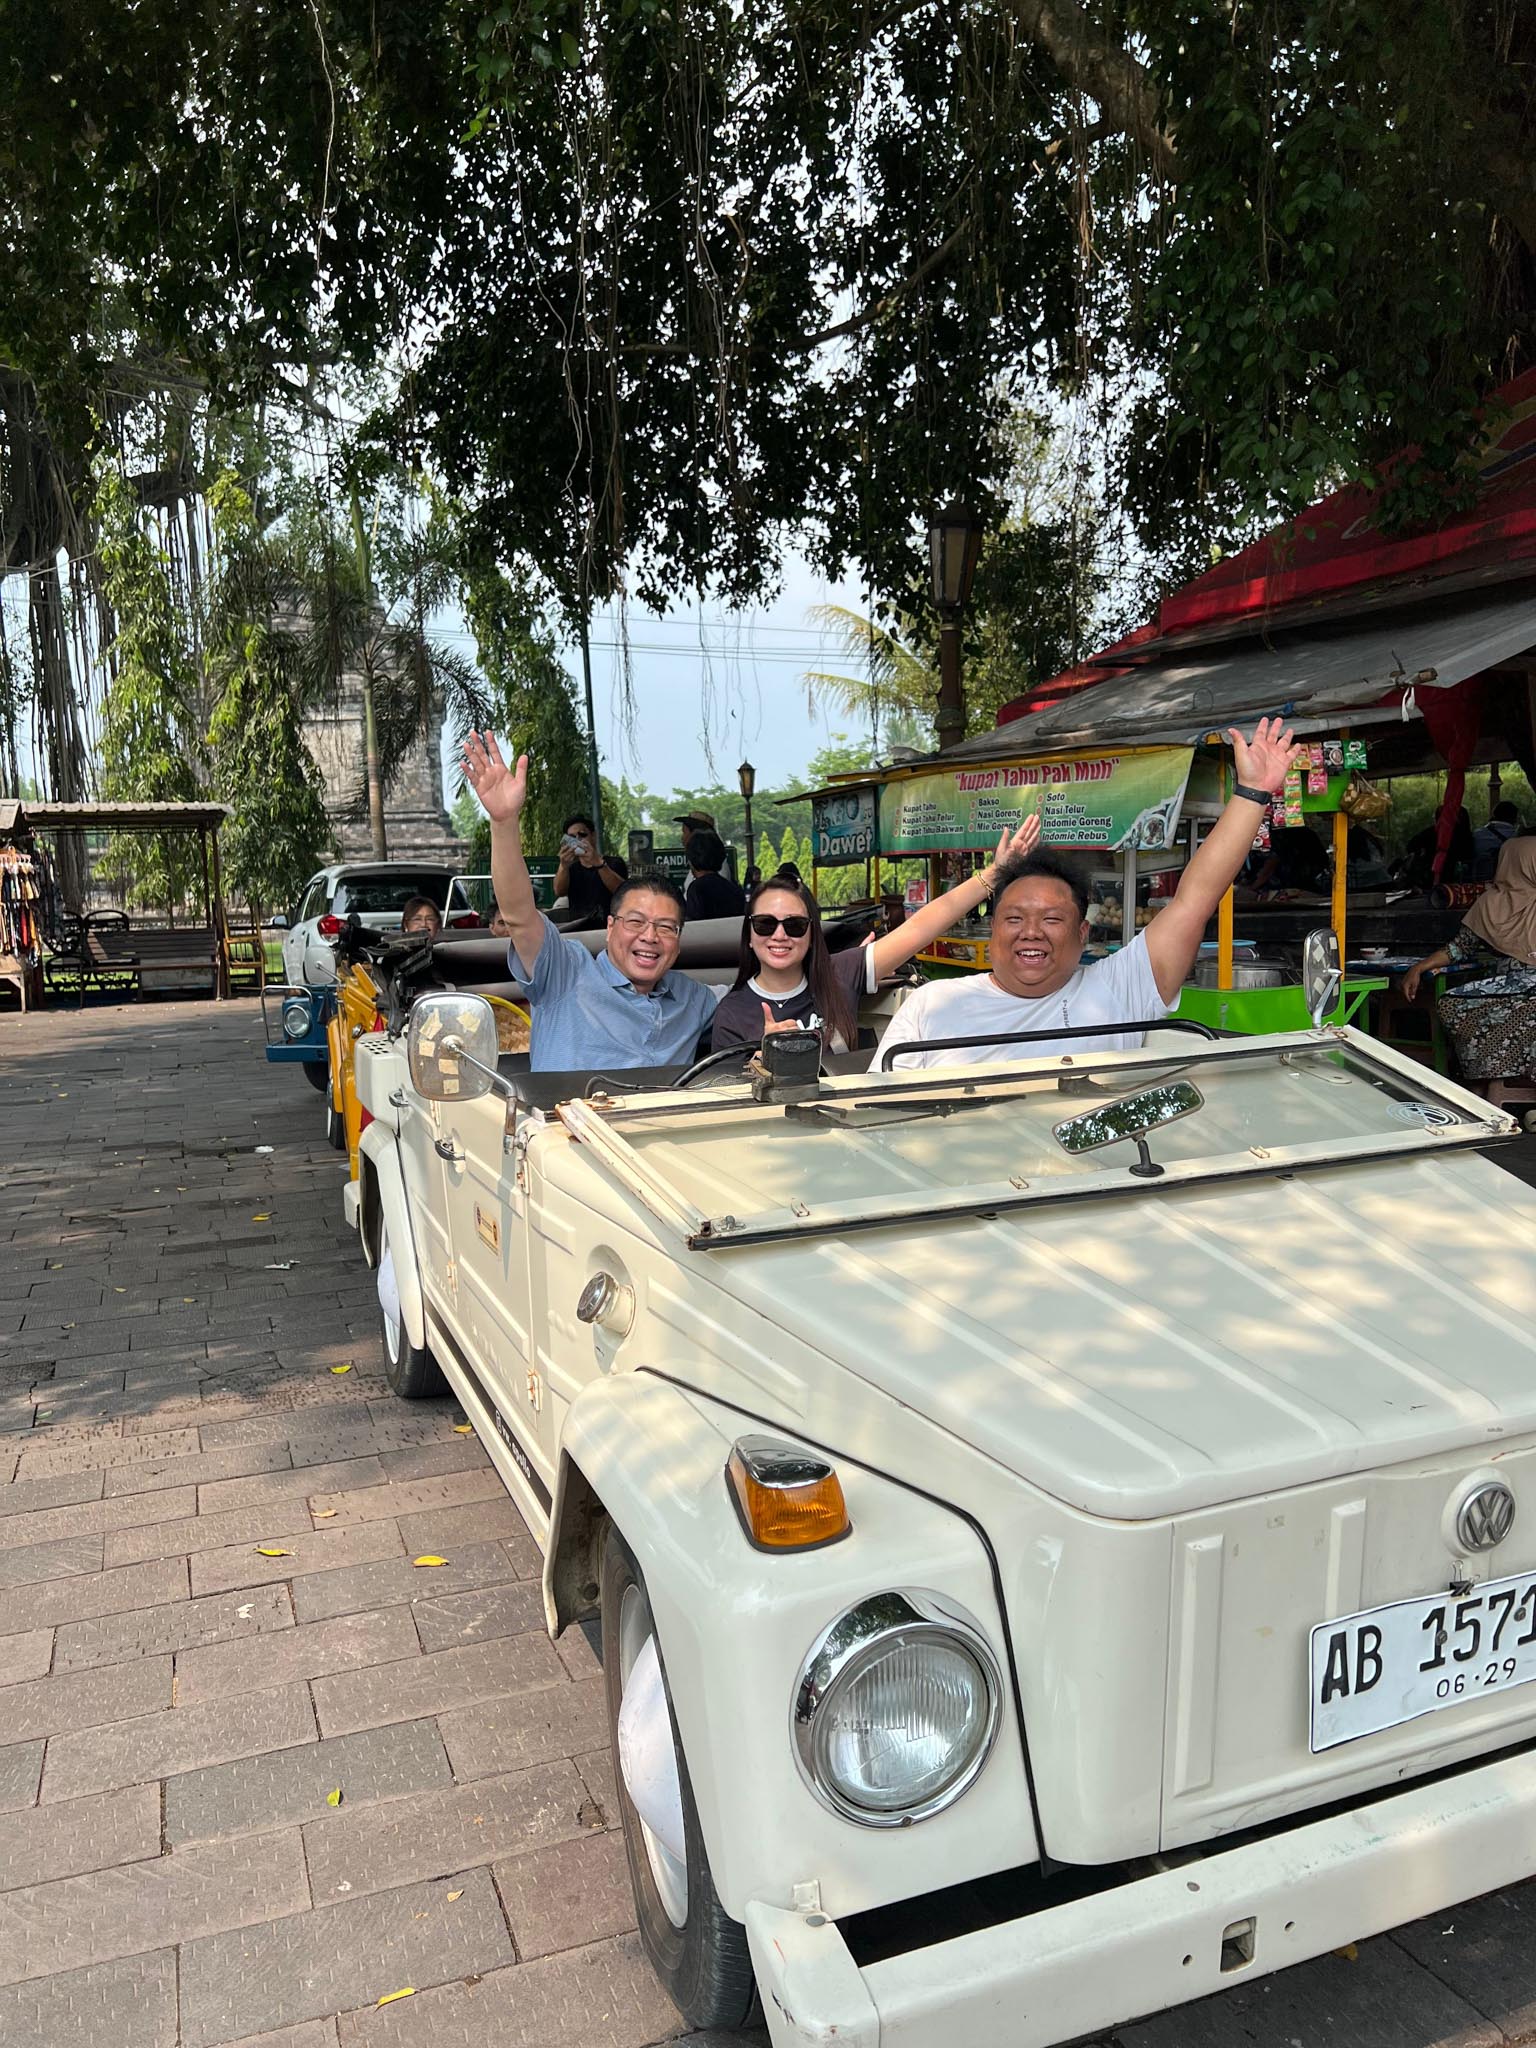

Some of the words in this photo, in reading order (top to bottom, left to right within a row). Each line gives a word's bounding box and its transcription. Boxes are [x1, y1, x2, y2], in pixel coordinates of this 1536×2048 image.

[1002, 767, 1038, 787] Tahu
[1041, 763, 1071, 784] Pak
[1046, 793, 1065, 801] Soto
[979, 798, 999, 807] Bakso
[903, 804, 922, 812] Kupat
[1045, 806, 1063, 815] Nasi
[1064, 805, 1085, 814] Telur
[902, 815, 922, 824] Kupat
[937, 814, 955, 822] Telur
[977, 811, 994, 819] Nasi
[995, 809, 1021, 818] Goreng
[1043, 818, 1077, 827] Indomie
[1079, 815, 1112, 828] Goreng
[902, 827, 922, 836] Kupat
[936, 825, 964, 833] Bakwan
[977, 823, 991, 831] Mie
[1042, 831, 1076, 841] Indomie
[1078, 830, 1107, 840] Rebus
[819, 828, 873, 857] Dawet
[656, 855, 686, 866] CANDI
[1321, 1624, 1383, 1704] AB
